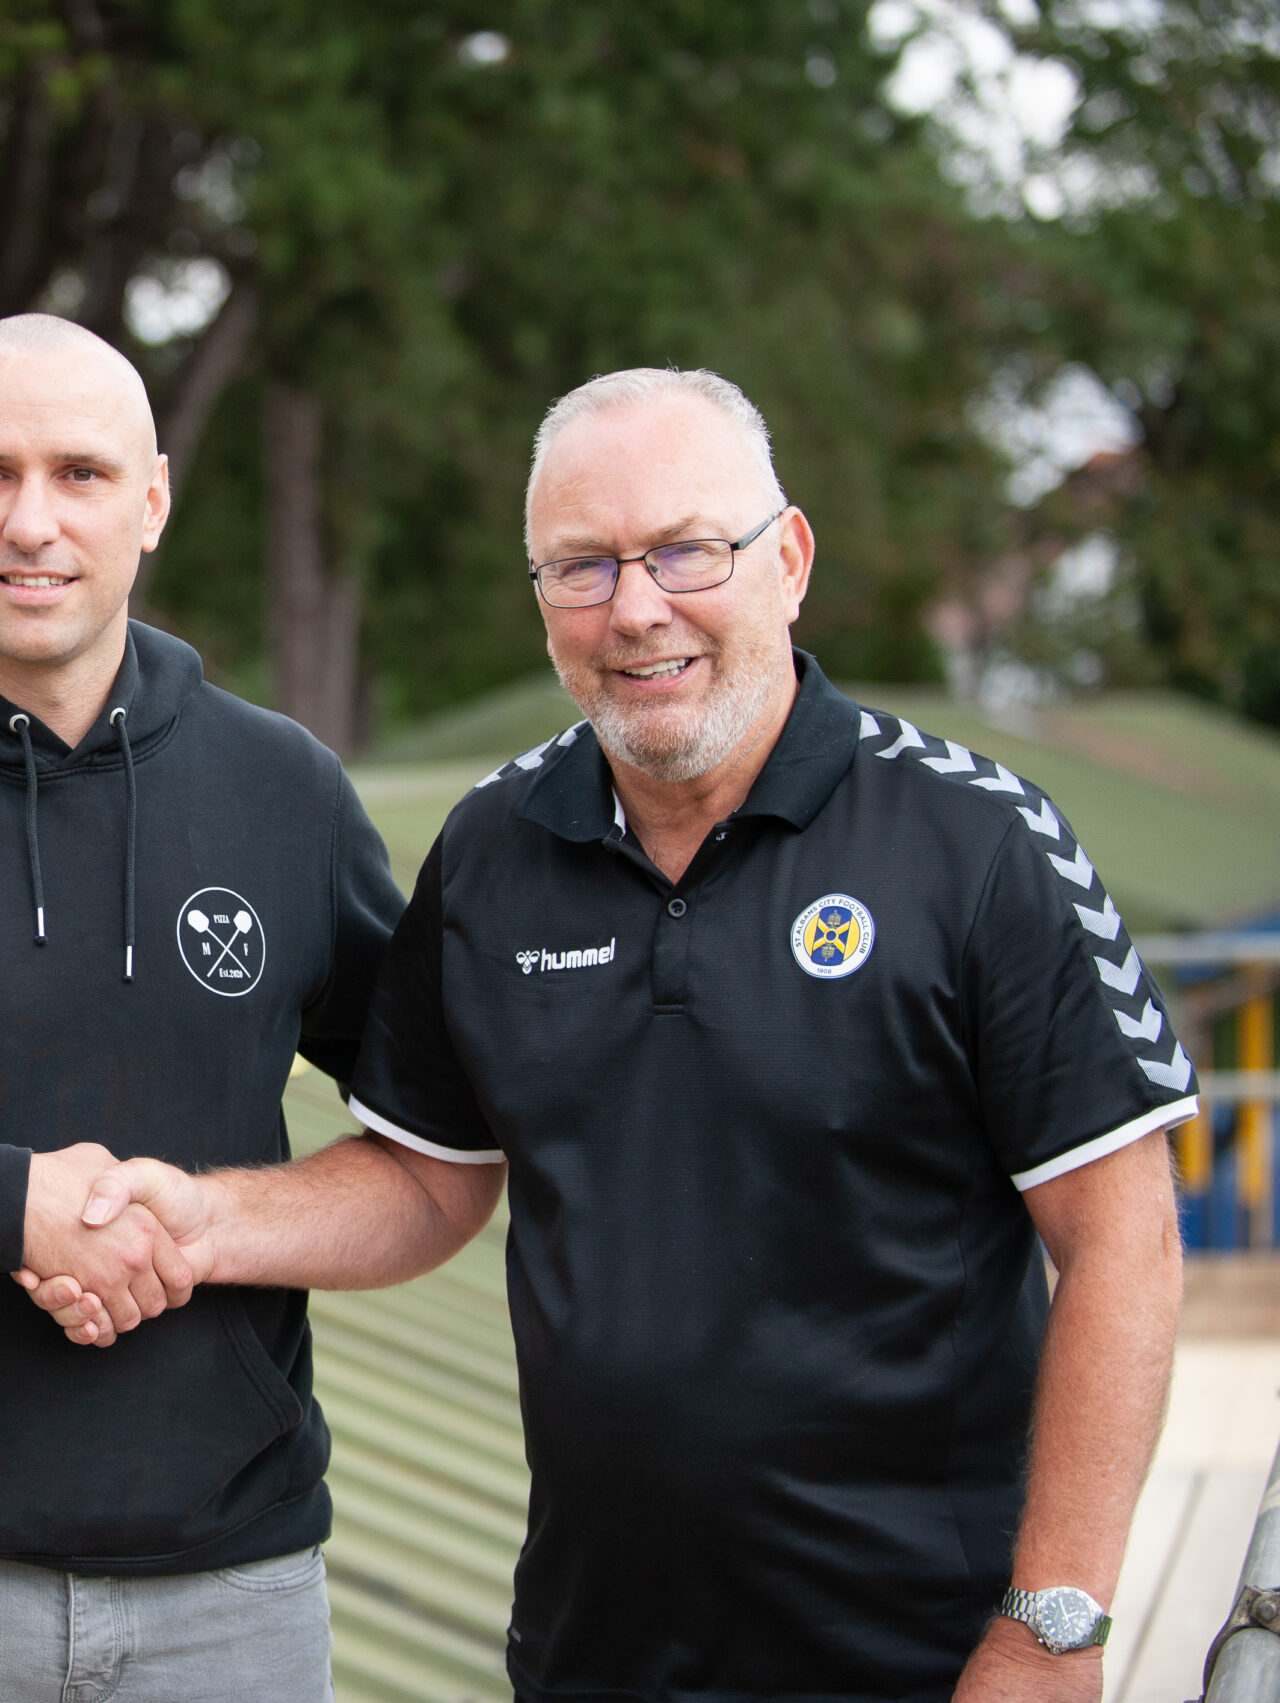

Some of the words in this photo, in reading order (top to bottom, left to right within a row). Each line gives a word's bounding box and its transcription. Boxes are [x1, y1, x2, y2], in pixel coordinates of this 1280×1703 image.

[818, 898, 837, 908] CITY
[838, 898, 869, 930] FOOTBALL
[796, 906, 817, 934] ALBANS
[202, 942, 211, 955] M
[795, 938, 801, 947] ST
[859, 932, 870, 954] CLUB
[541, 937, 616, 972] hummel
